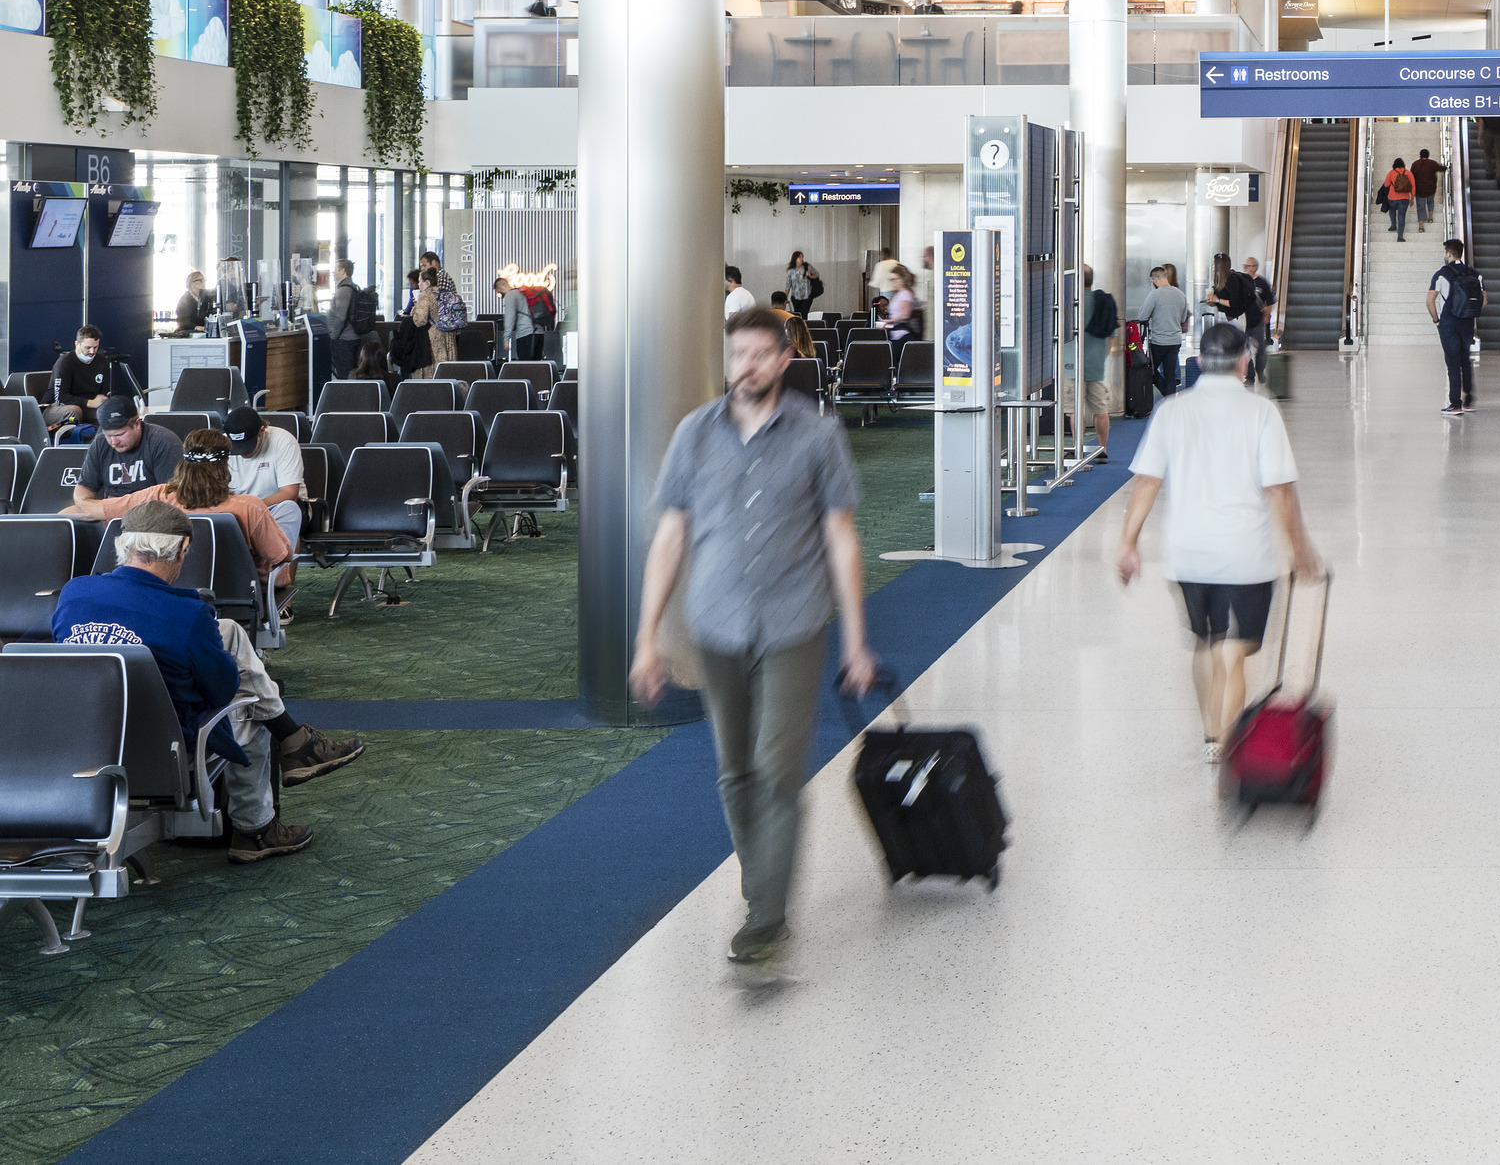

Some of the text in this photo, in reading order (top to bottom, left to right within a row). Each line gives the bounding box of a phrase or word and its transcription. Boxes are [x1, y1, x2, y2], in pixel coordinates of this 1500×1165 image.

[1254, 68, 1330, 81] Restrooms
[1399, 67, 1476, 81] Concourse
[1479, 66, 1492, 80] C
[1429, 95, 1470, 109] Gates
[87, 154, 110, 185] B6
[822, 193, 862, 201] Restrooms
[1205, 178, 1241, 200] Good
[461, 232, 474, 320] OFFEE BAR
[73, 623, 142, 645] Eastern Idaho
